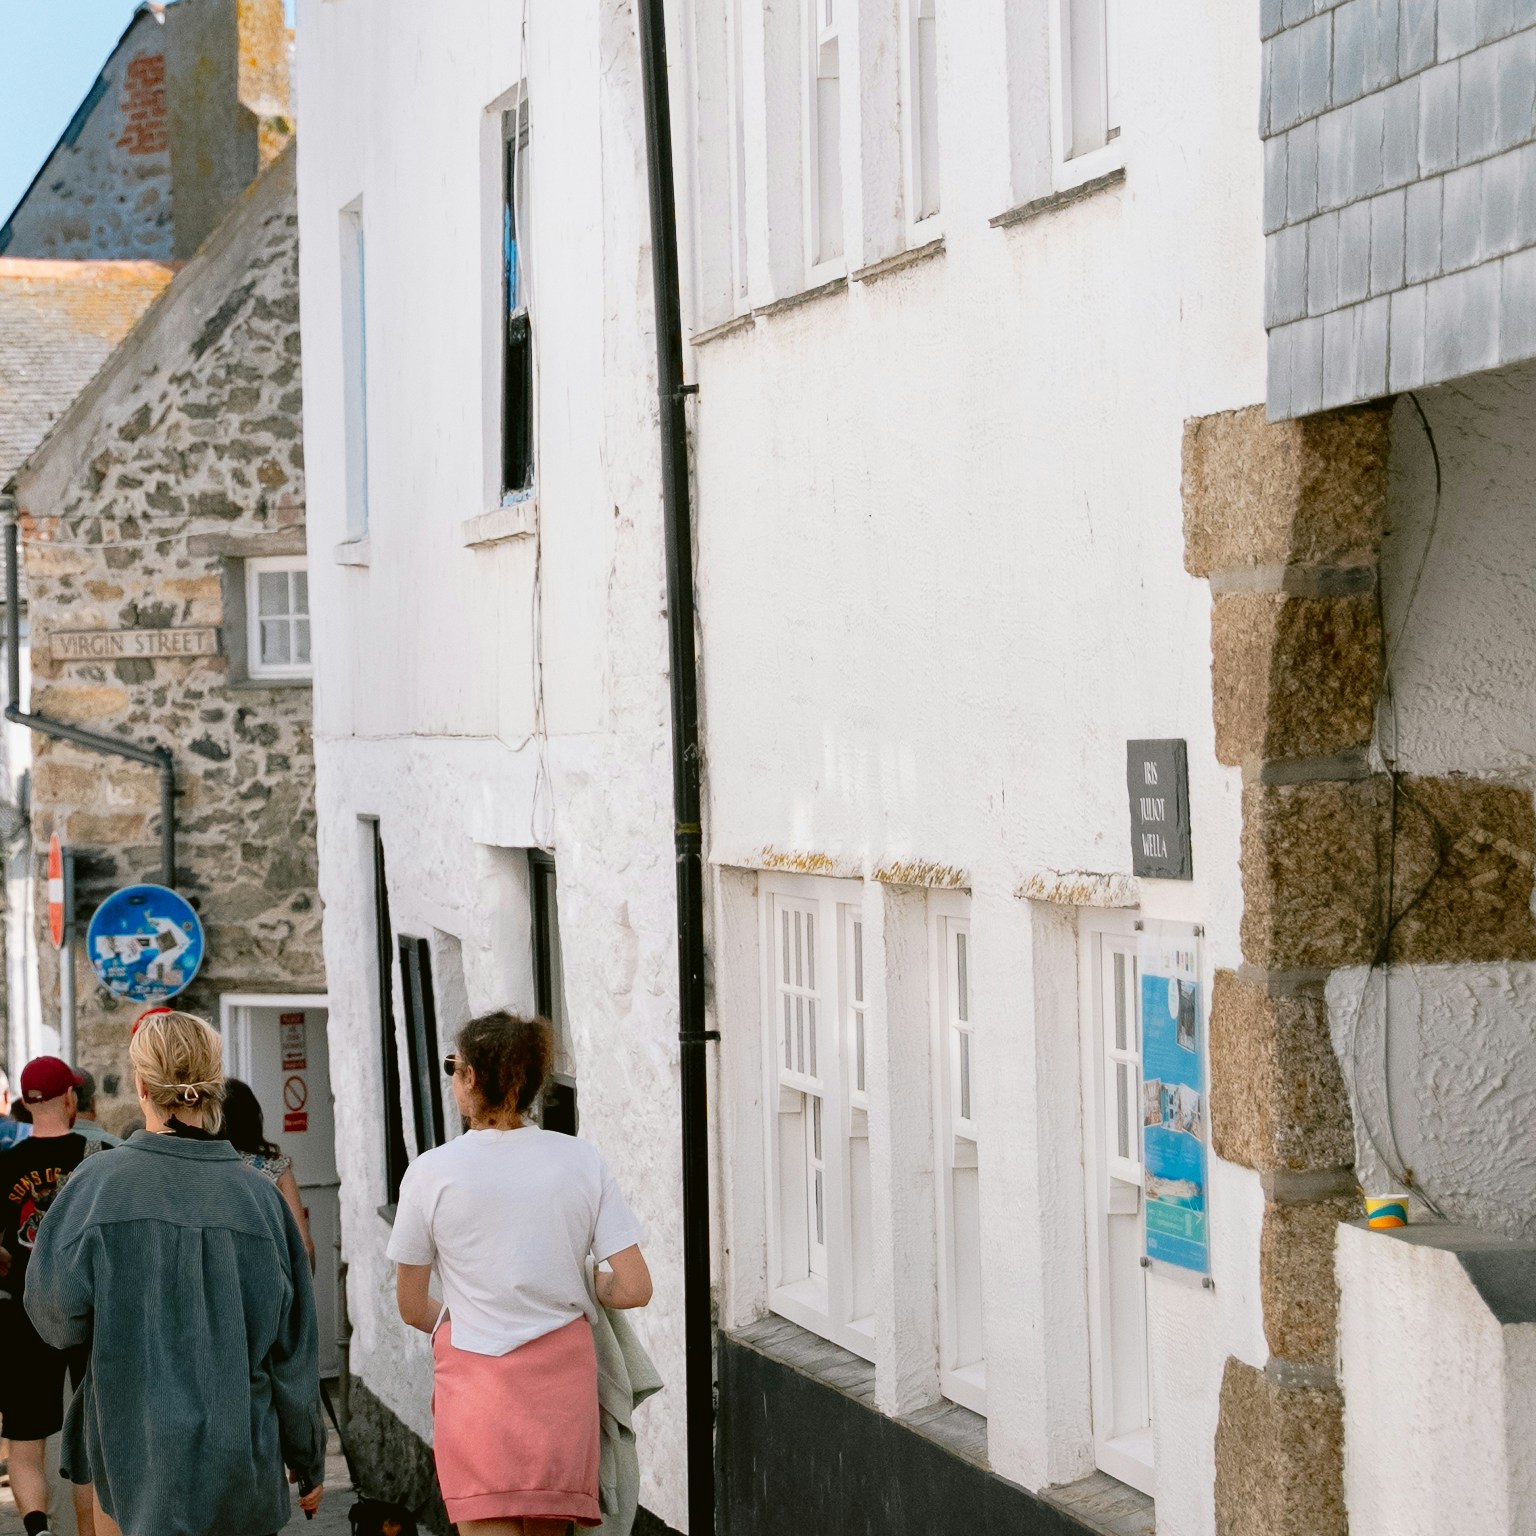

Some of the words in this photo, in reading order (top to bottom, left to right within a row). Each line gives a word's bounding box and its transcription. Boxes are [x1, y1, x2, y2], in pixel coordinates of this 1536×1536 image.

[60, 634, 124, 656] VIRGIN
[135, 631, 205, 654] STREET
[1143, 761, 1158, 785] IRIS
[1139, 796, 1165, 825] JULIOT
[1141, 832, 1168, 858] WELLA
[8, 1170, 42, 1204] SONS
